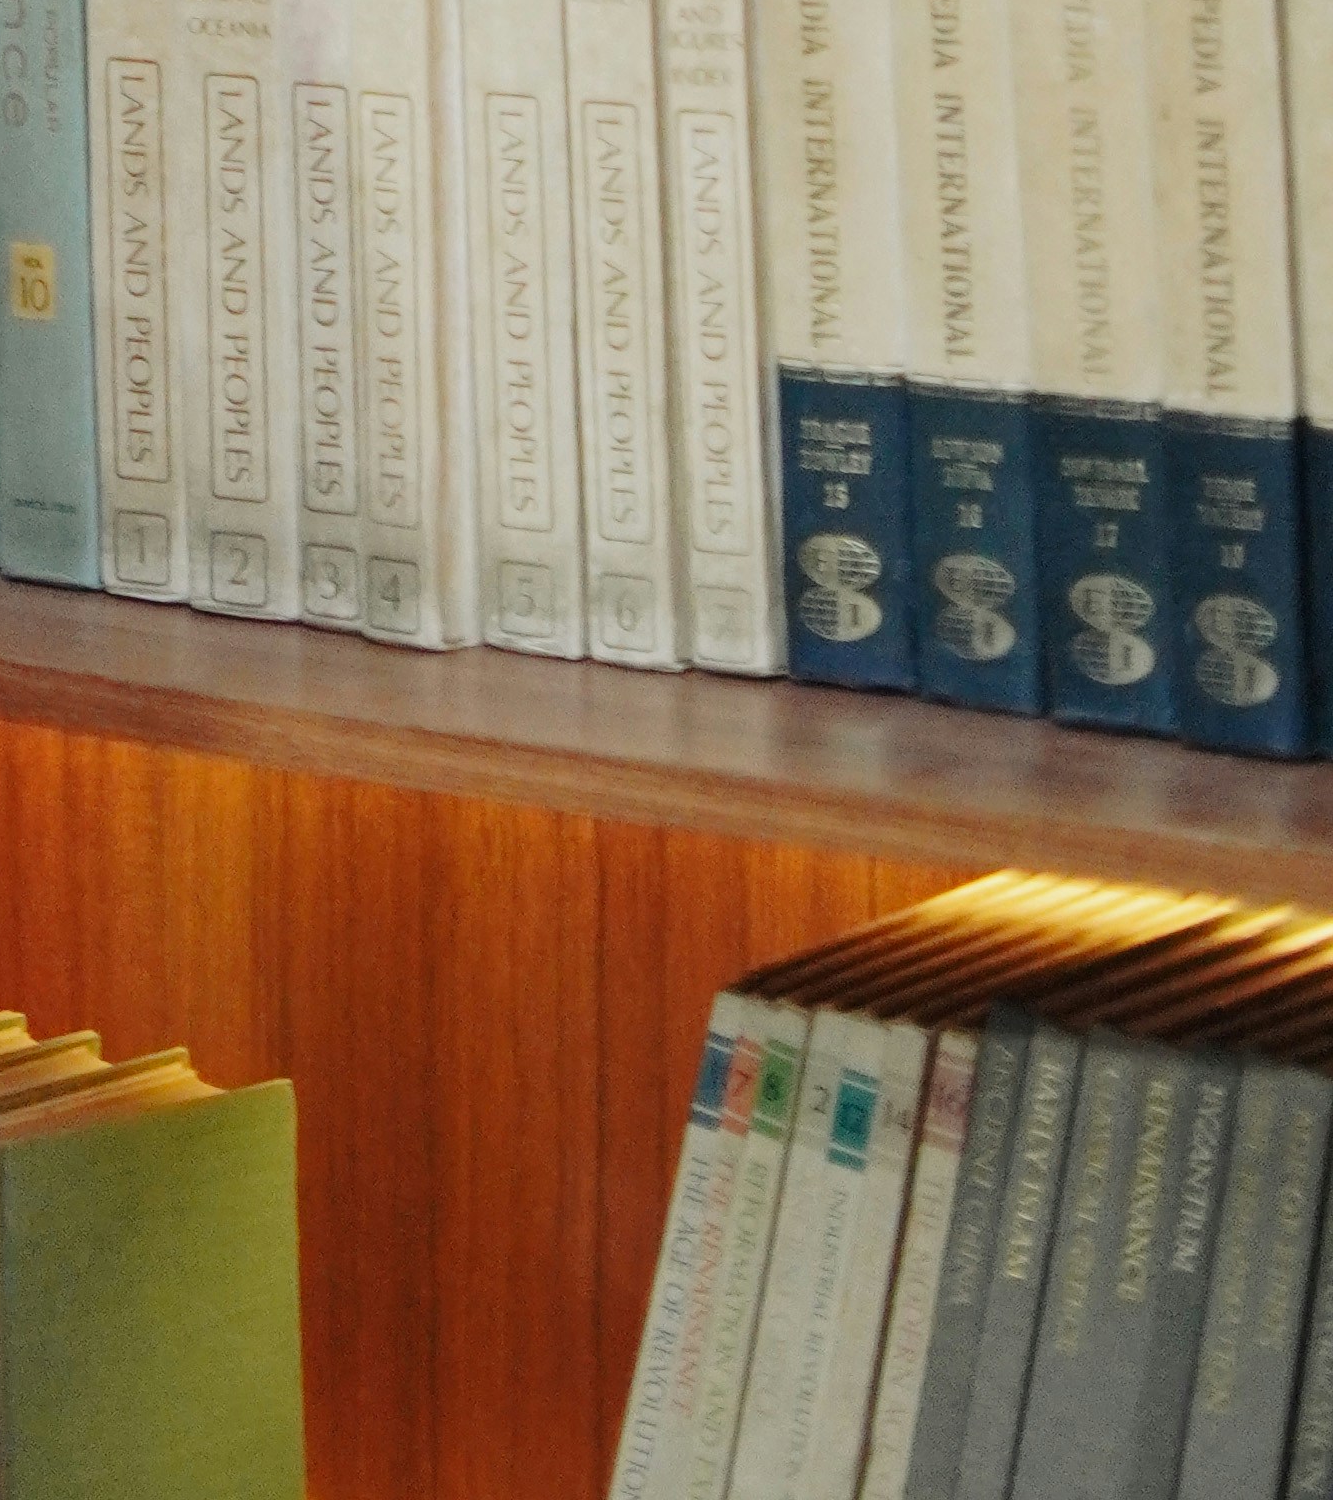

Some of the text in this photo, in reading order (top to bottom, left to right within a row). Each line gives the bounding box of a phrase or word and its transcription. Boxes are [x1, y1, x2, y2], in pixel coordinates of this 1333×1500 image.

[19, 275, 50, 312] 10
[120, 68, 154, 463] LANDS AND PEOPLES
[215, 85, 252, 483] LANDS AND PEOPLES
[306, 97, 344, 498] LANDS AND PEOPLES
[370, 106, 405, 510] LANDS AND PEOPLES
[497, 111, 535, 515] LANDS AND PEOPLES
[594, 118, 636, 526] LANDS AND PEOPLES
[691, 127, 733, 537] LANDS AND PEOPLES
[801, 78, 841, 350] INTERNATIONAL
[934, 90, 975, 364] INTERNATIONAL
[1195, 117, 1236, 400] INTERNATIONAL
[228, 545, 251, 586] 2
[1172, 1080, 1229, 1274] BYZANTIUM
